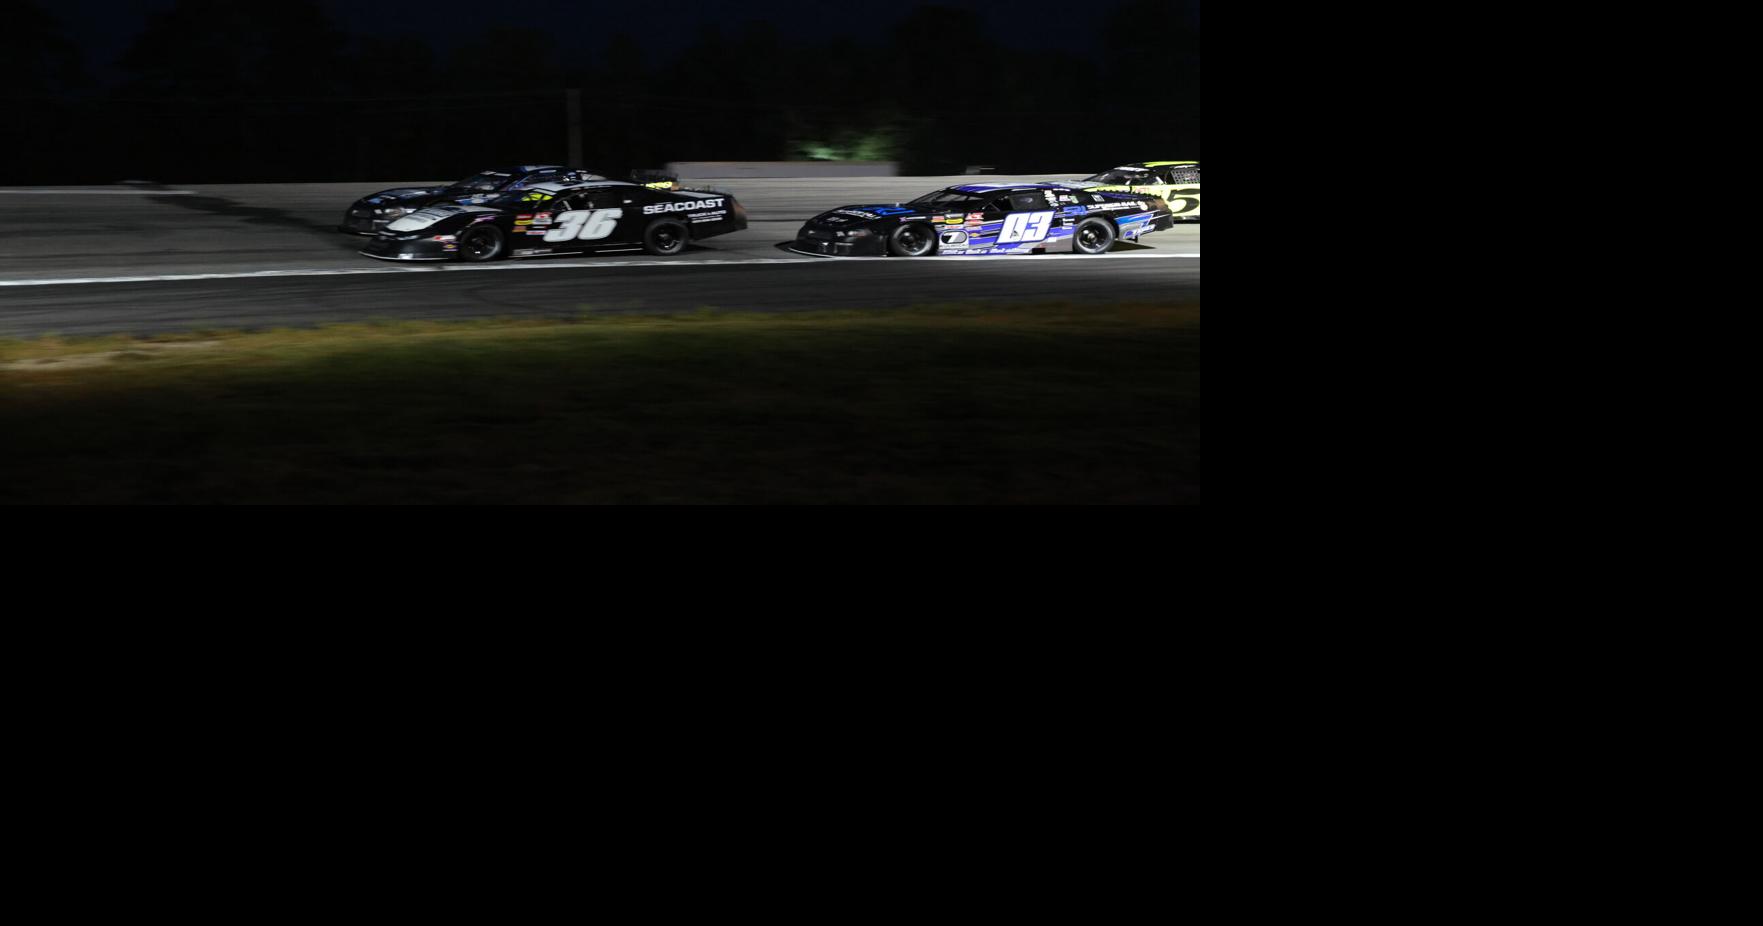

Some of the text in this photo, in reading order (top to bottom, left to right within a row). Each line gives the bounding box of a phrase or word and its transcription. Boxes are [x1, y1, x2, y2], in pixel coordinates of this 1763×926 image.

[643, 198, 725, 214] SEACOAST
[1167, 188, 1200, 213] 5
[543, 207, 623, 243] 36
[997, 211, 1055, 244] 03
